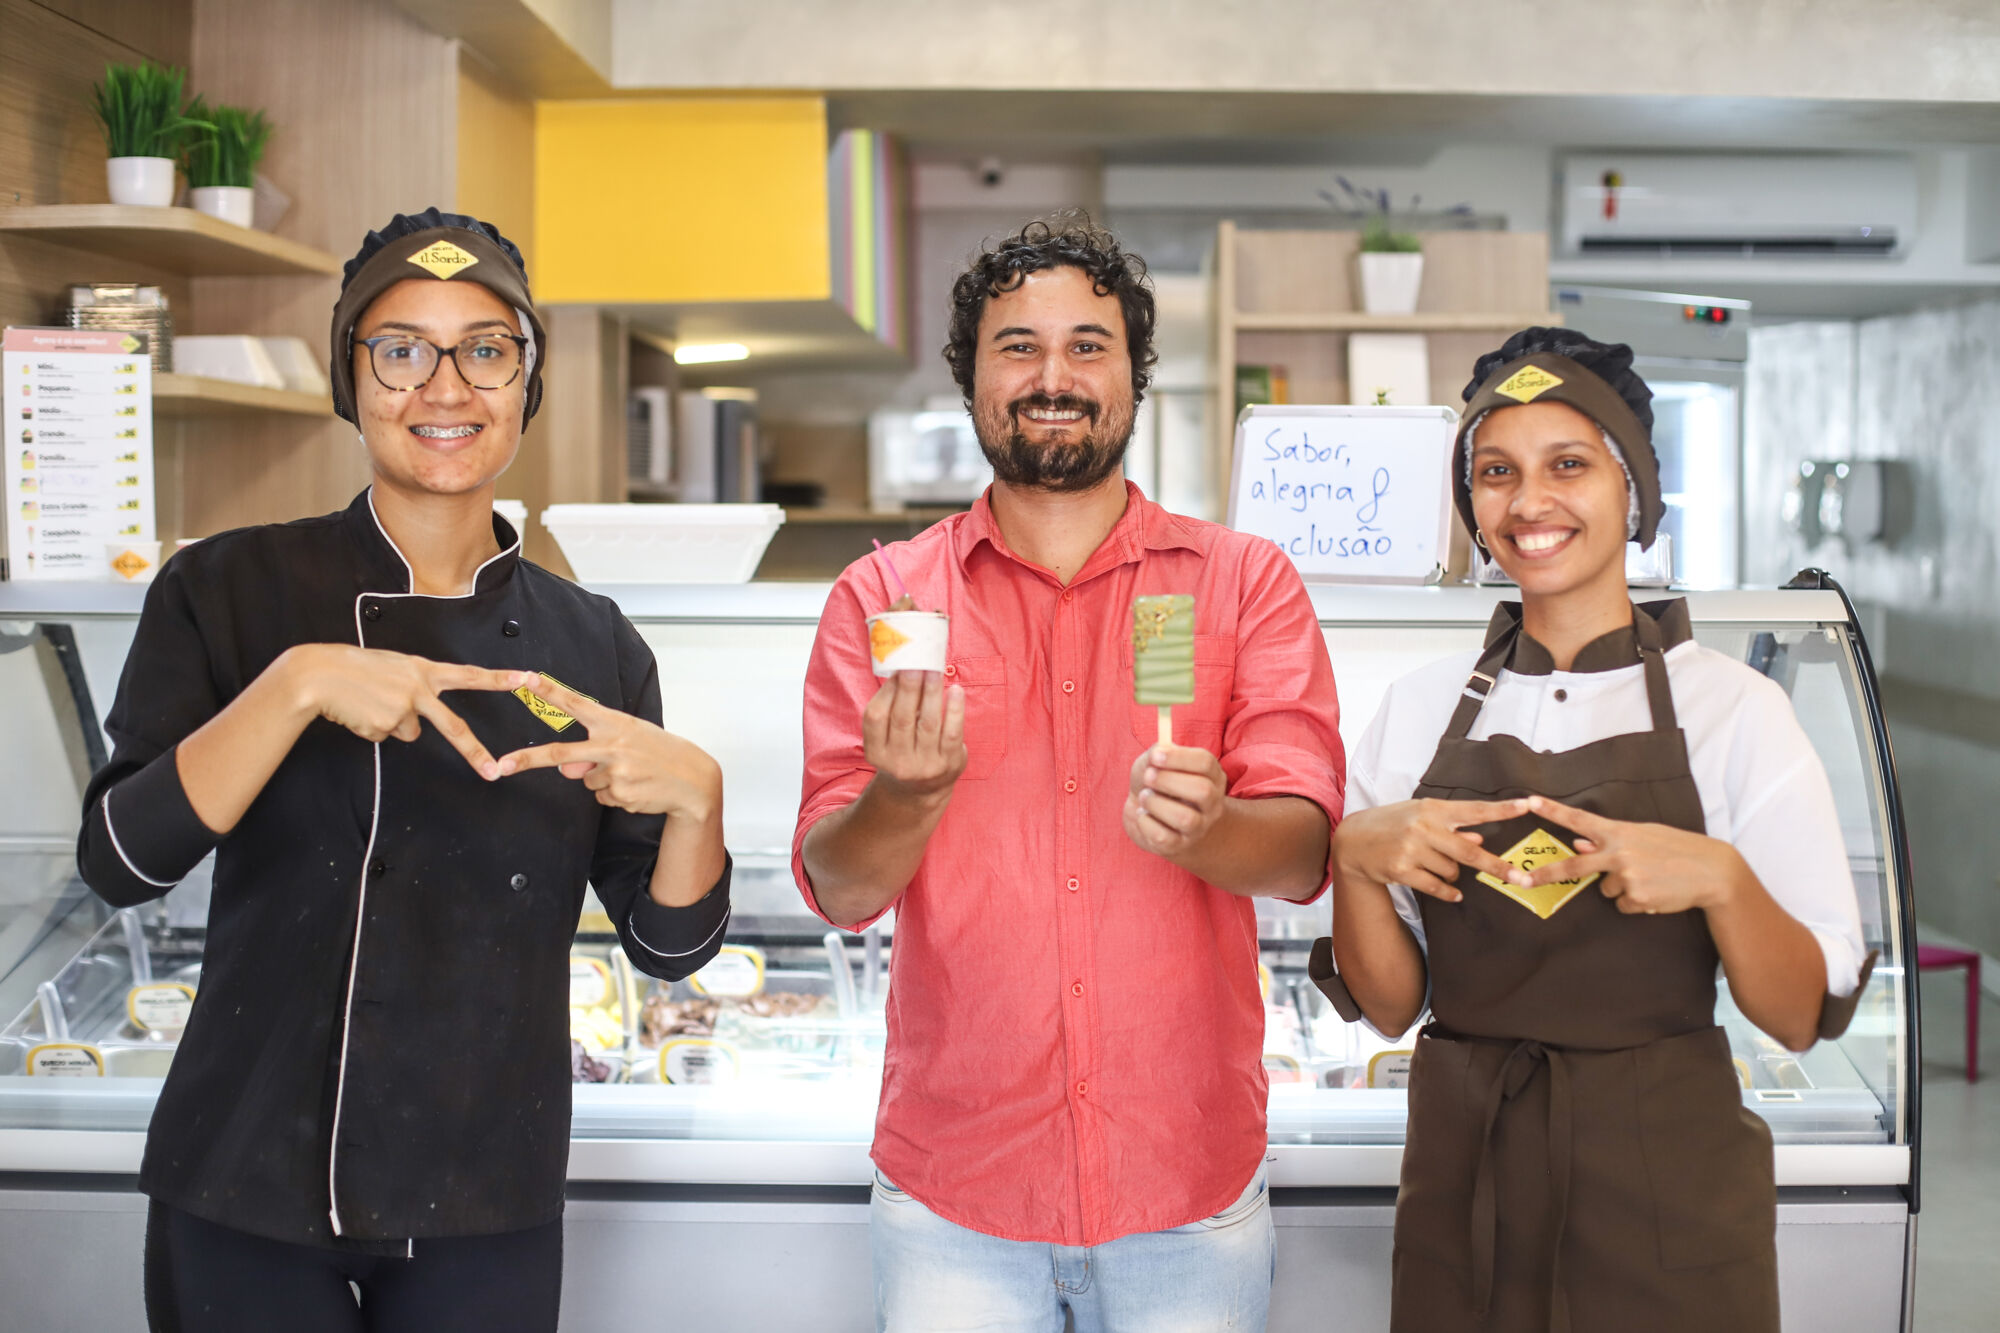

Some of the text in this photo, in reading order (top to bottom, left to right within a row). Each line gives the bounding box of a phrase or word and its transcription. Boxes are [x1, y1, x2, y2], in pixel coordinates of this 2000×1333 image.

[431, 251, 467, 264] Sordo
[1263, 428, 1351, 467] Sabor,
[1251, 467, 1355, 513] alegria
[1270, 523, 1392, 557] clusão
[1523, 846, 1557, 855] GELATO
